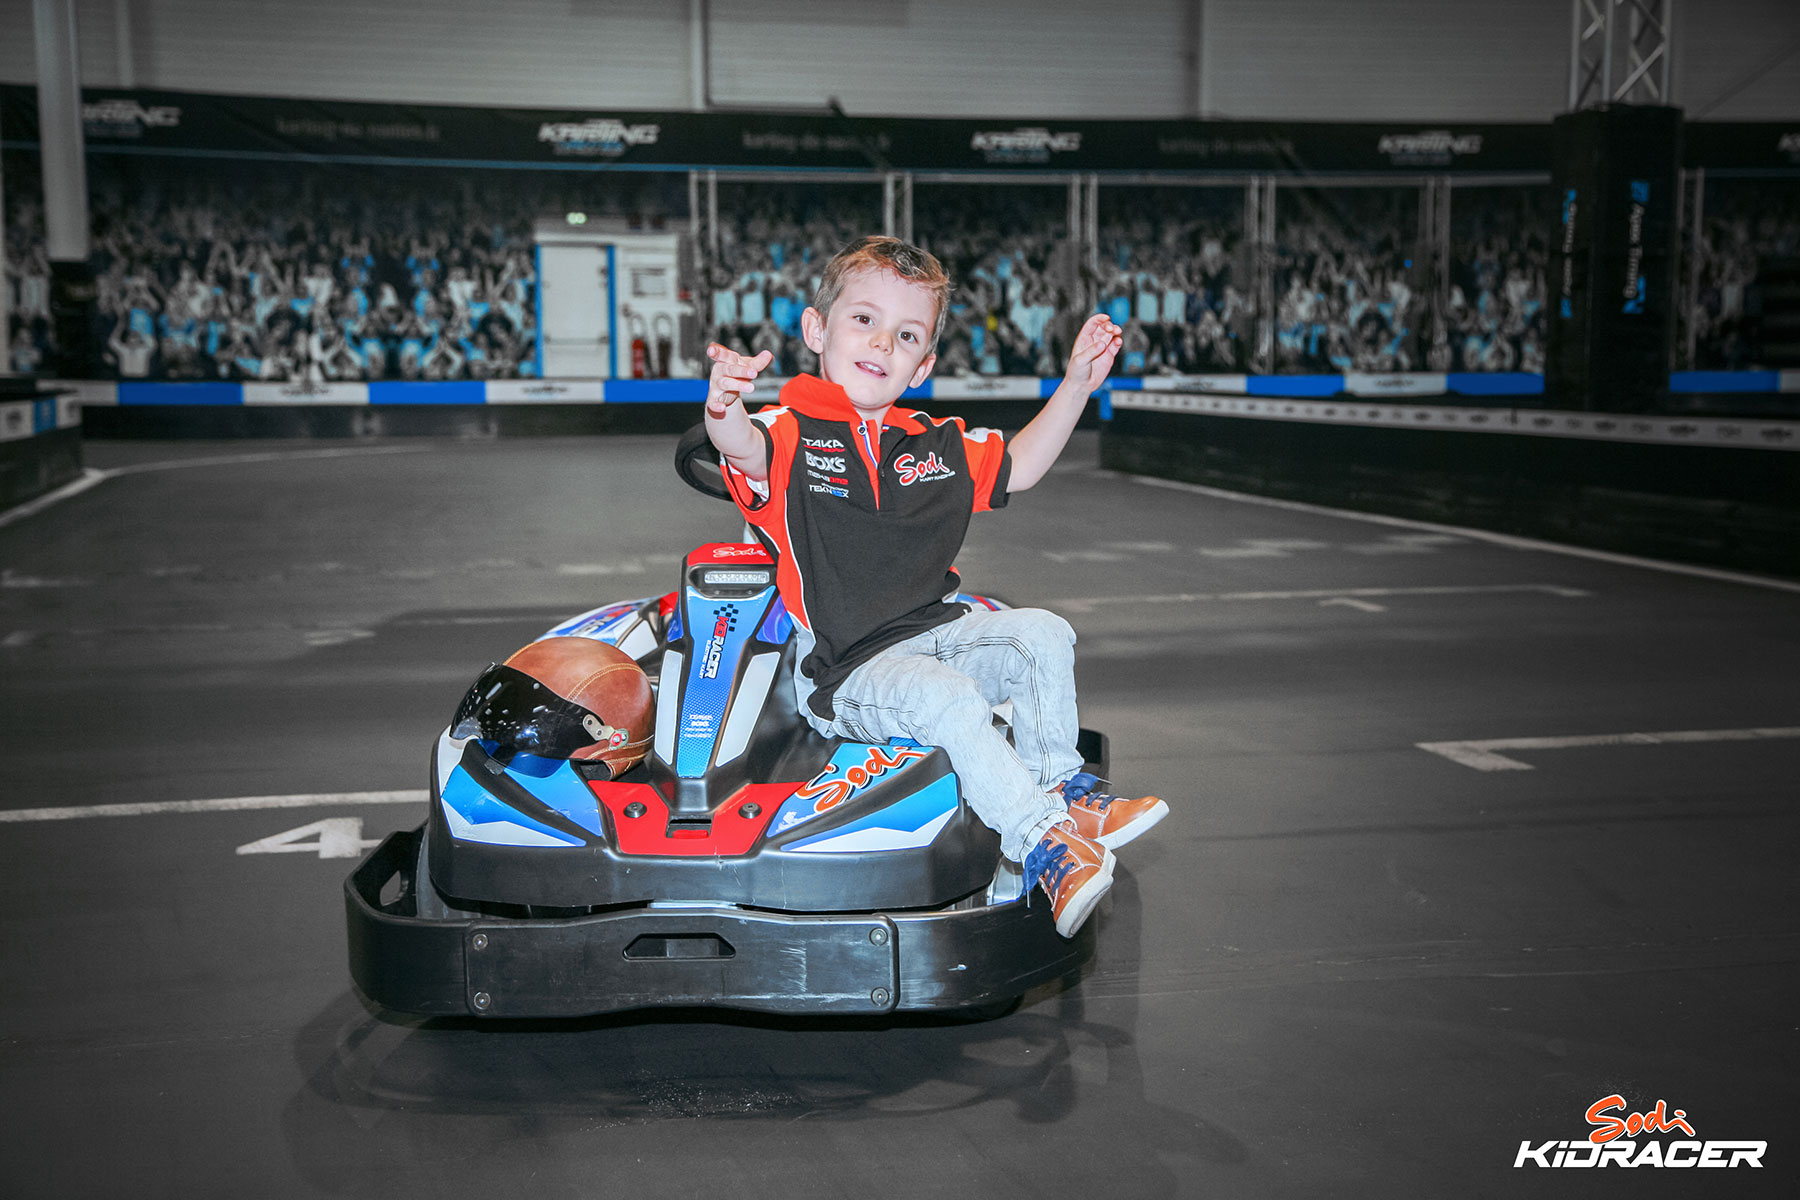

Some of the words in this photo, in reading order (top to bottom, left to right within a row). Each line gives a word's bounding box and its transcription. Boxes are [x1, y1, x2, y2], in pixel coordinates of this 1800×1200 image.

[801, 437, 844, 448] TAKA
[805, 451, 846, 473] BOX'S
[894, 451, 950, 486] Sodi
[795, 746, 926, 814] Sodi
[235, 817, 384, 859] 4
